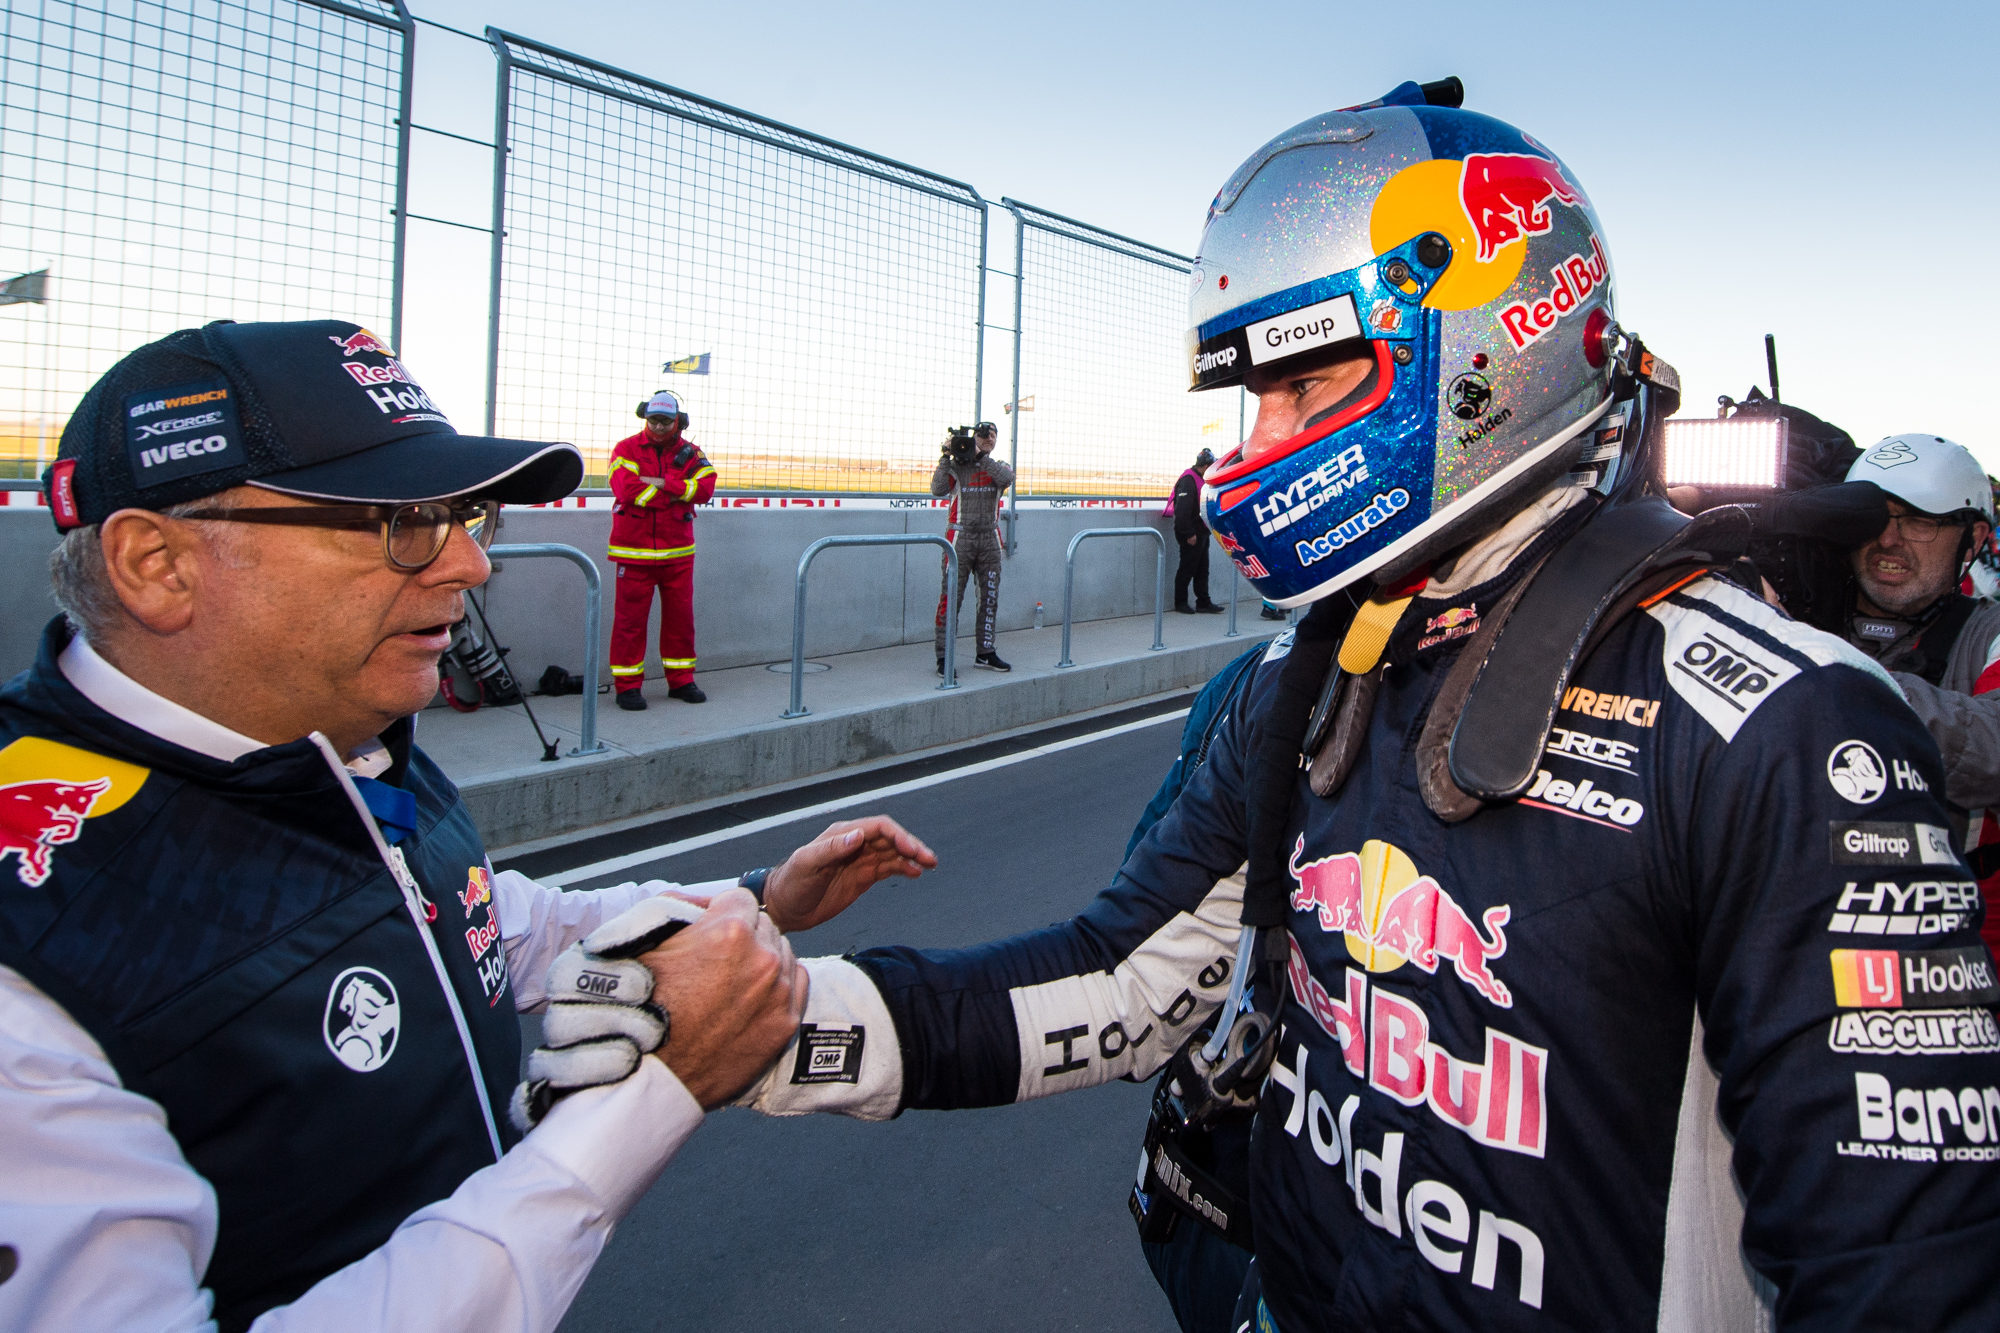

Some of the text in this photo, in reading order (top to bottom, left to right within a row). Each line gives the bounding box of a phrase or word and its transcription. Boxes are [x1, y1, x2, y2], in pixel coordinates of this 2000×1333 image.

[1495, 263, 1579, 353] Red
[1194, 317, 1335, 374] Giltrap Group
[341, 357, 409, 386] Red
[130, 389, 228, 418] GEARWRENCH
[1458, 408, 1512, 449] Holden
[140, 435, 227, 468] IVECO
[1253, 444, 1365, 523] HYPER
[1309, 464, 1370, 511] DRIVE
[889, 500, 928, 508] NORTH
[1050, 500, 1077, 508] NORTH
[1297, 489, 1408, 565] Accurate
[984, 571, 997, 649] SUPERCARS
[1418, 627, 1452, 650] Red
[1866, 624, 1892, 634] rpm
[1684, 641, 1768, 696] OMP
[1892, 759, 1929, 792] Ho
[1843, 829, 1910, 858] Giltrap
[1836, 881, 1979, 912] HYPER
[577, 974, 619, 994] OMP
[1864, 955, 1992, 1003] LJ Hooker
[1836, 1006, 1998, 1048] Accurate
[814, 1053, 841, 1065] OMP
[1287, 929, 1548, 1159] Red Bull
[1270, 1024, 1545, 1310] Holden
[1837, 1141, 1938, 1163] LEATHER
